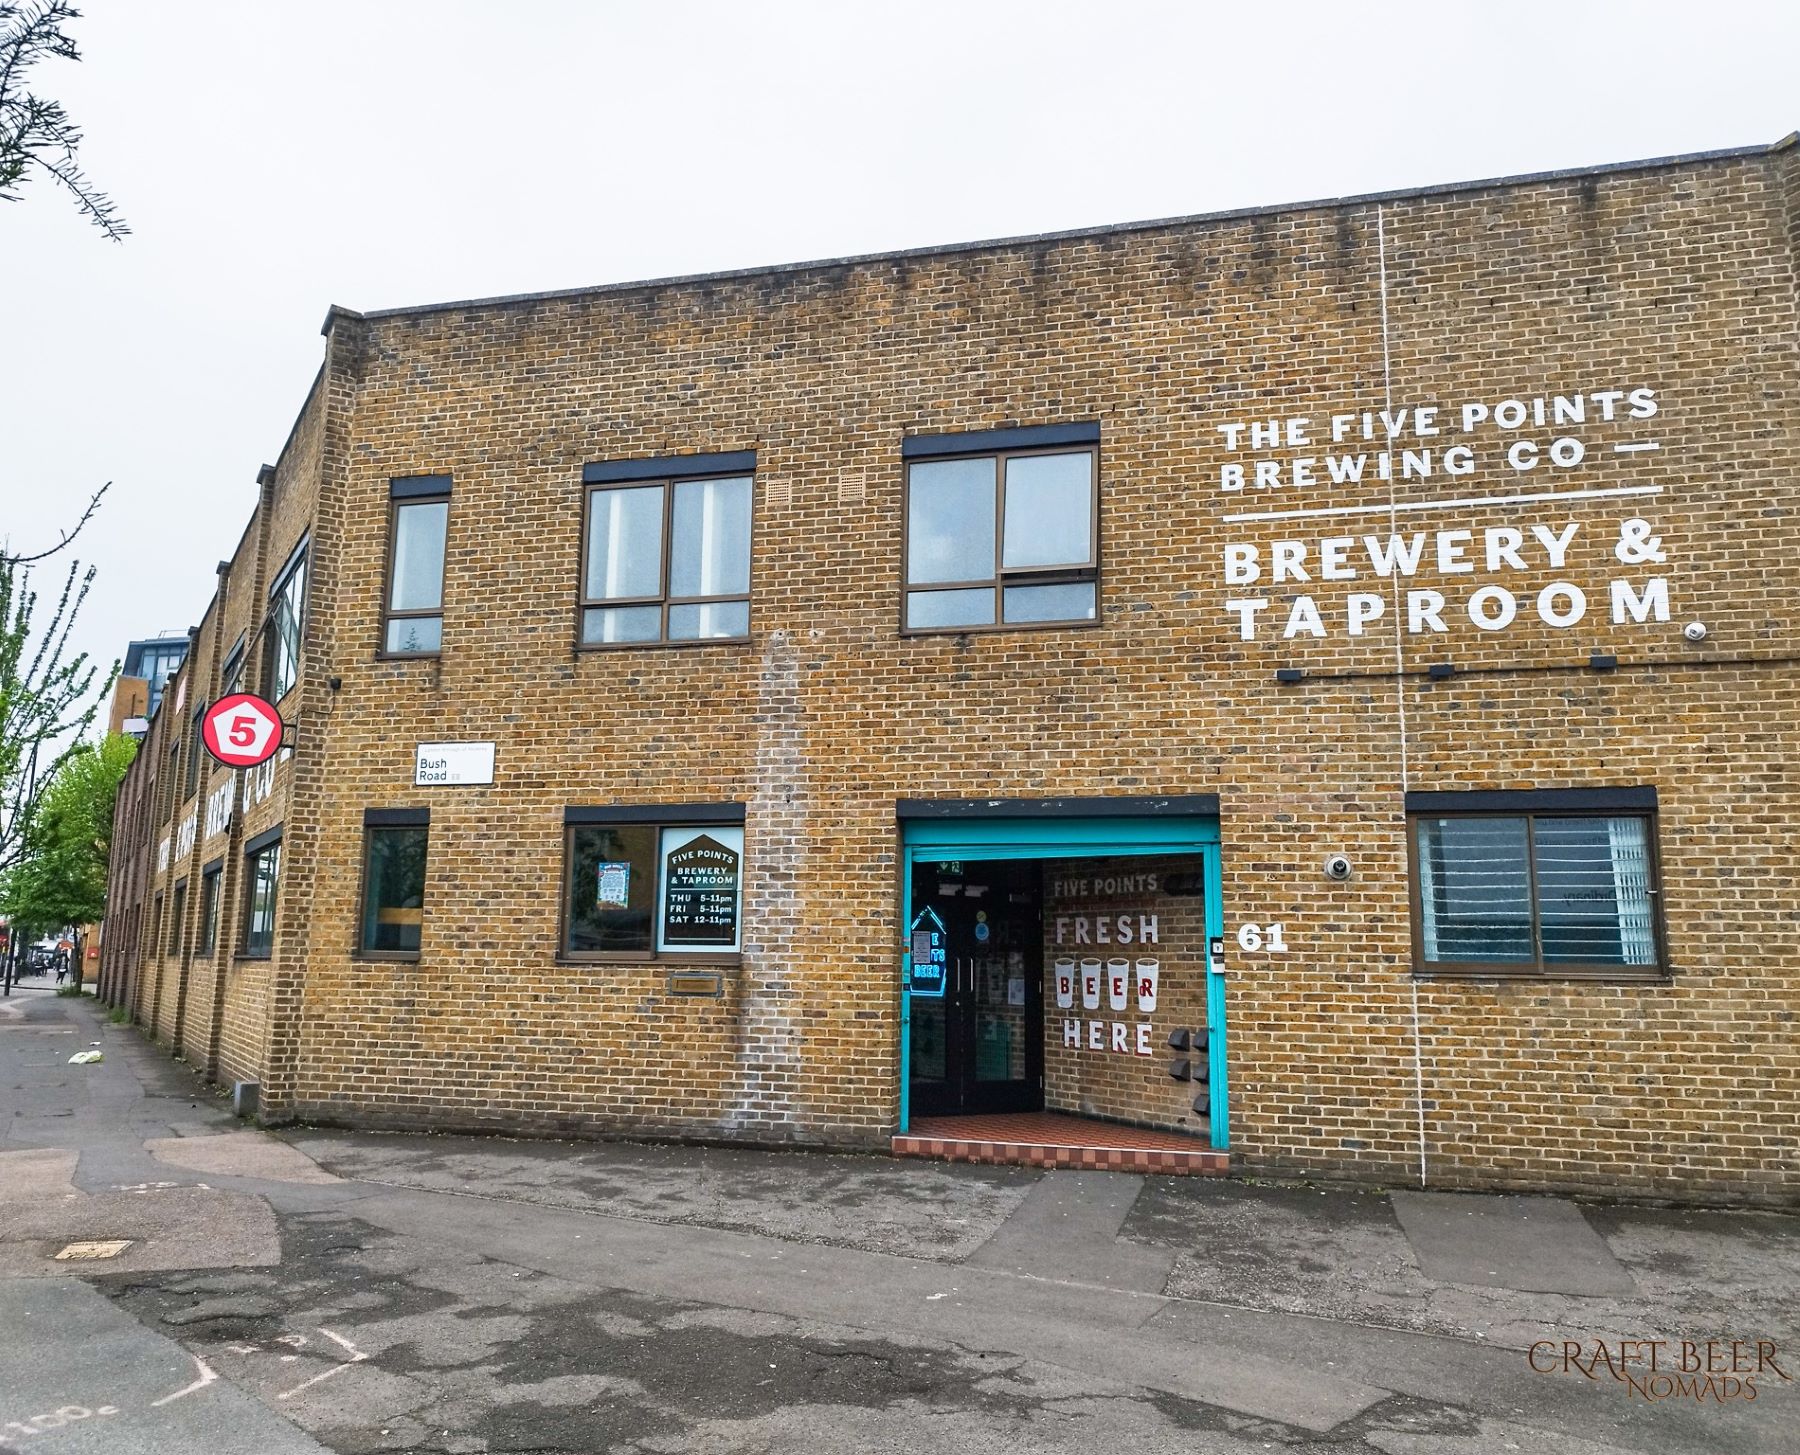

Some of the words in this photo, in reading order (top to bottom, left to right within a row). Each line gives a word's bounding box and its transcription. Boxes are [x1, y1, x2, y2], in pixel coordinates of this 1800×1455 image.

[1217, 417, 1311, 452] THE
[1331, 405, 1440, 443] FIVE
[1461, 387, 1659, 432] POINTS
[1220, 446, 1475, 492] BREWING
[1507, 437, 1585, 471] CO
[1223, 523, 1580, 585] BREWERY
[1614, 518, 1667, 564] &
[1225, 578, 1671, 641] TAPROOM
[228, 715, 257, 747] 5
[420, 758, 447, 769] Bush
[419, 770, 447, 781] Road
[671, 850, 694, 865] FIVE
[697, 849, 734, 864] POINTS
[670, 876, 678, 884] &
[681, 876, 733, 884] TAPROOM
[677, 866, 727, 875] BREWERY
[1054, 879, 1088, 897] FIVE
[1094, 873, 1158, 896] POINTS
[669, 904, 686, 913] FRI
[699, 904, 732, 915] 5-11pm
[670, 894, 691, 902] THU
[700, 894, 732, 904] 5-11pm
[669, 915, 689, 924] SAT
[1055, 914, 1159, 944] FRESH
[1237, 923, 1289, 952] 61
[914, 964, 940, 978] BEER
[1060, 976, 1154, 997] BEER
[1063, 1019, 1154, 1056] HERE
